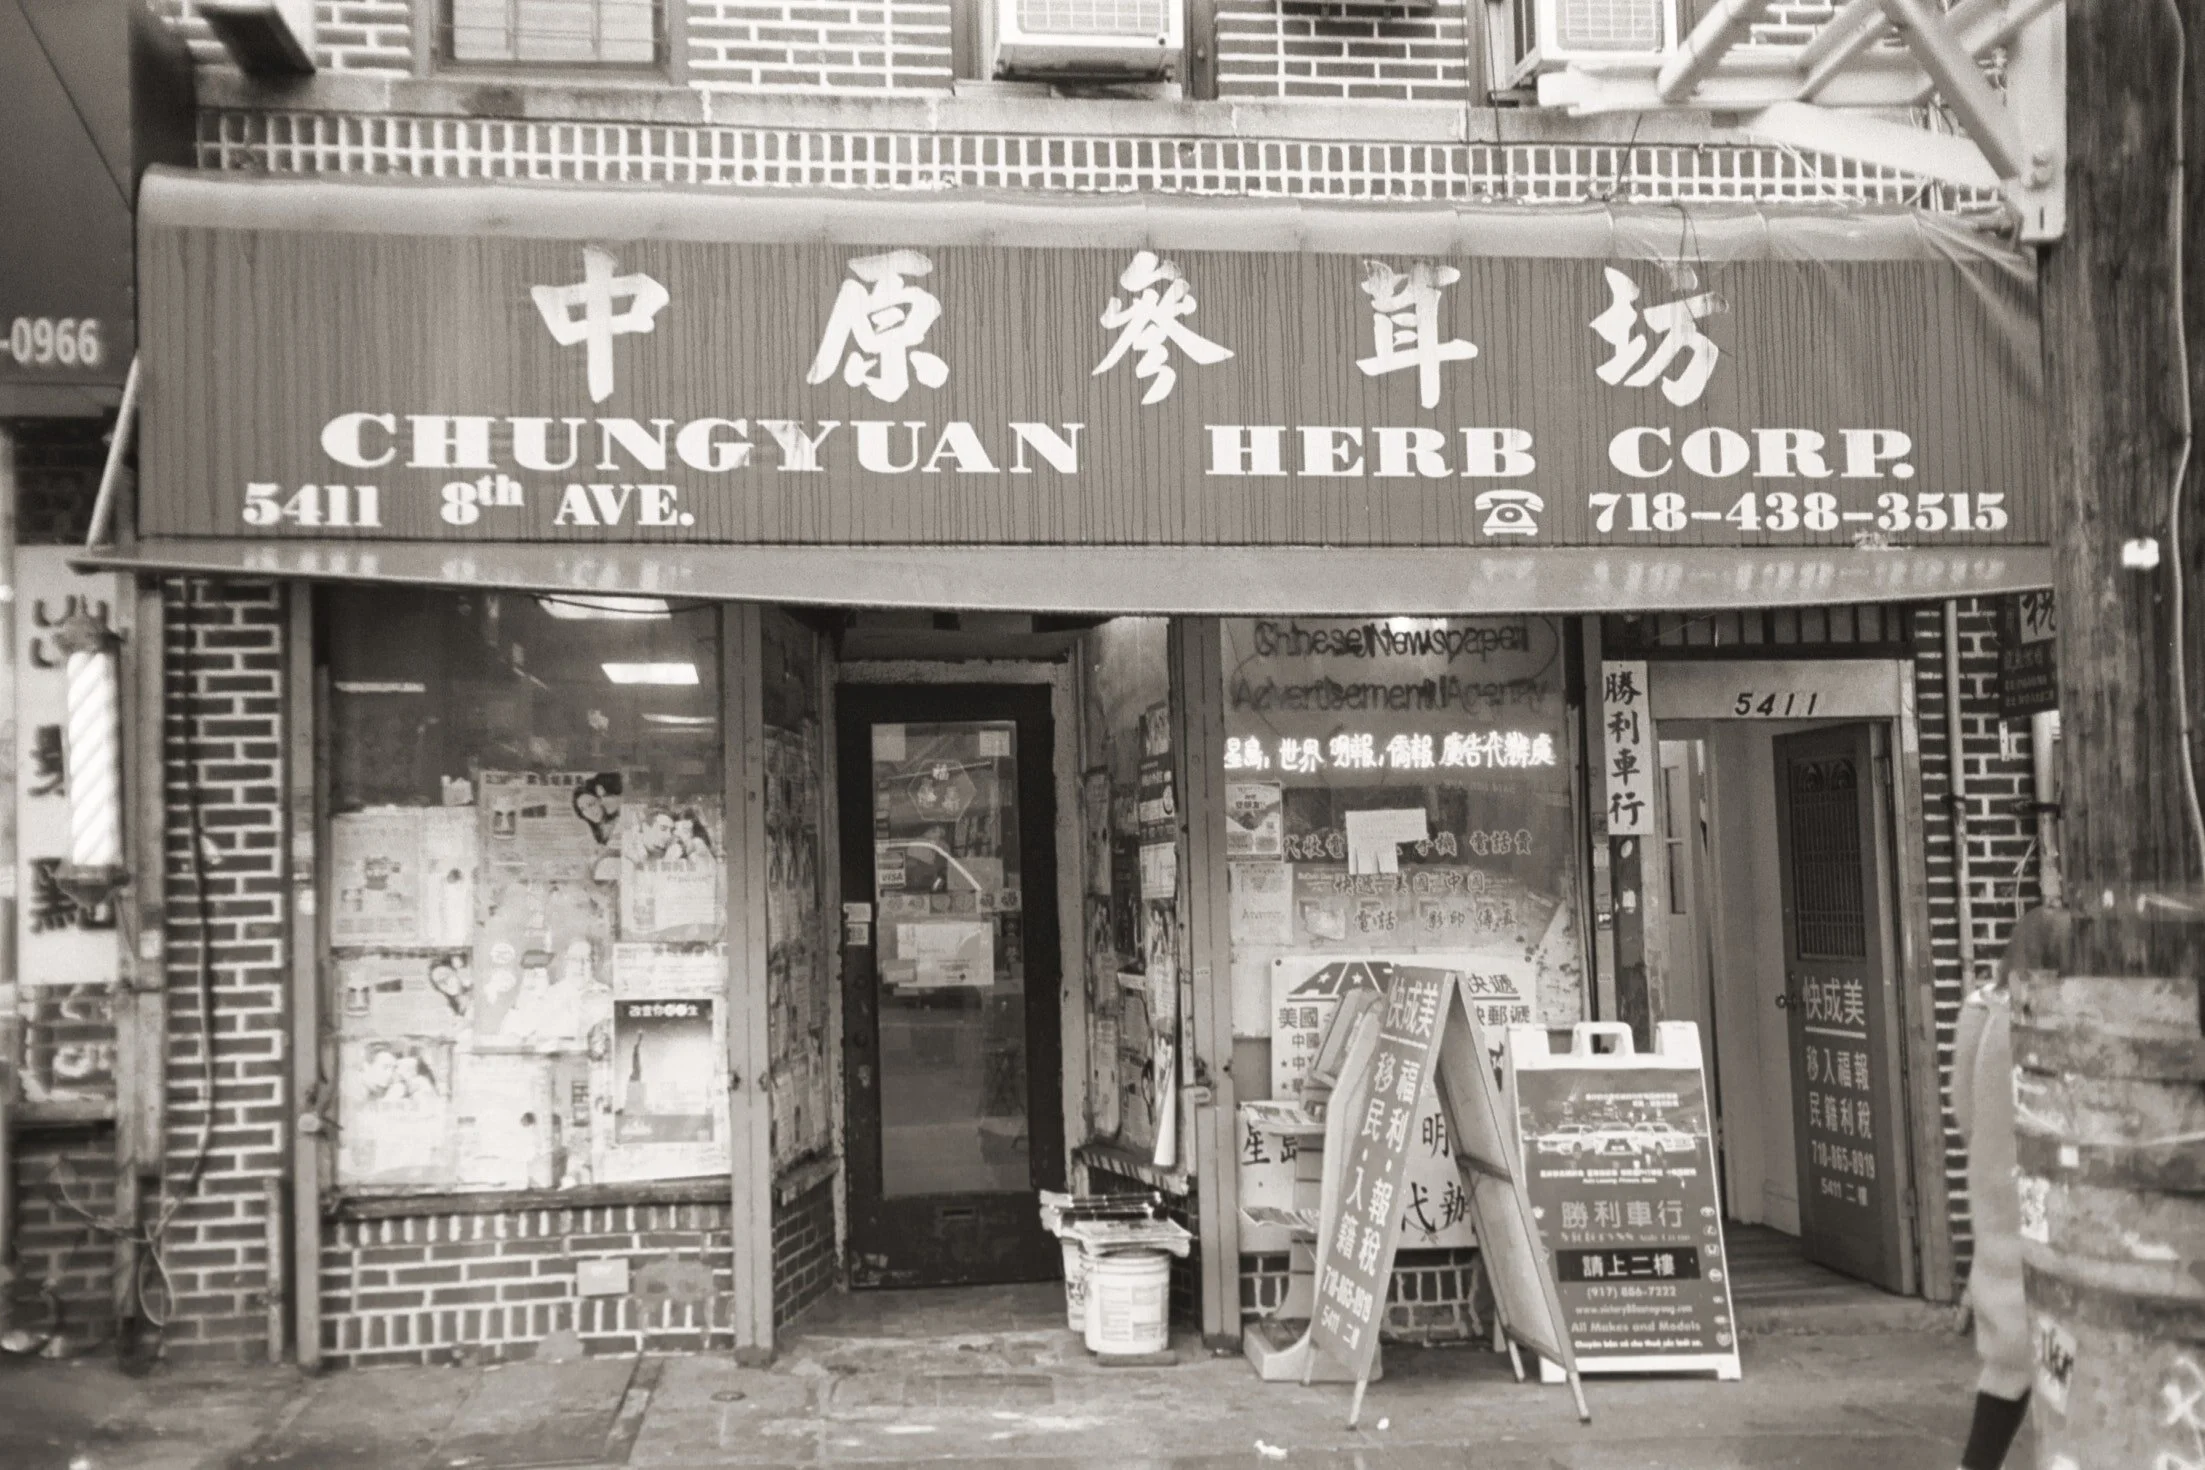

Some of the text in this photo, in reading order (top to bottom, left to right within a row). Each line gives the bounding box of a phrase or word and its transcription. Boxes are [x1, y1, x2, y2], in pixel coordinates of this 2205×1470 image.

[321, 413, 1915, 479] CHUNGYUAN HERB CORP.
[243, 474, 695, 528] 5411 8th AVE.
[1588, 491, 2008, 532] 718-438-3515
[1735, 692, 1818, 717] 5411
[1603, 671, 1644, 827] 勝利車行
[1560, 1199, 1684, 1229] 勝利車行
[1581, 1253, 1676, 1278] 請上二樓
[1571, 1322, 1587, 1333] All
[1632, 1320, 1656, 1332] and
